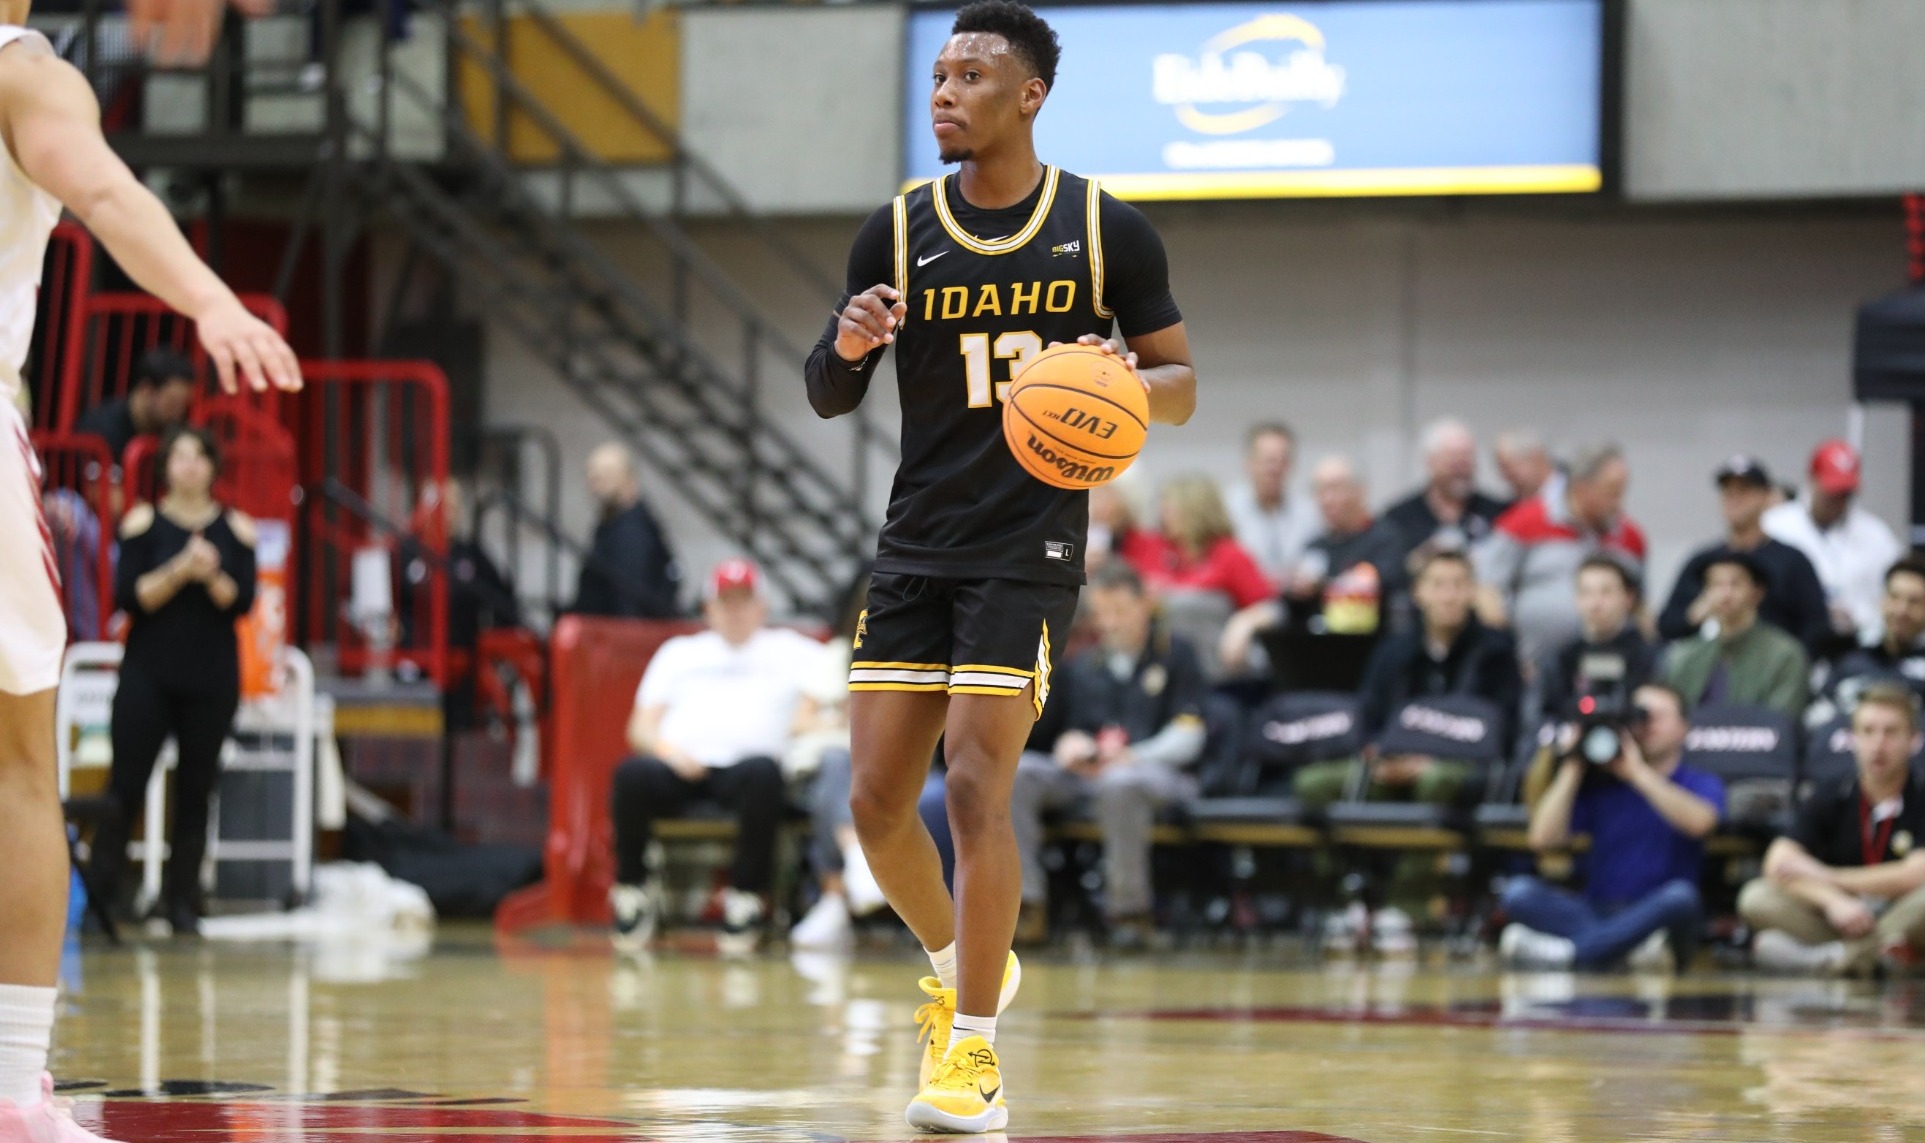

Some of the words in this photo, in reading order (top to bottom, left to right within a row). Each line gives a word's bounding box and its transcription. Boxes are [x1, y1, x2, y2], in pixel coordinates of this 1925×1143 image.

[923, 280, 1076, 320] IDAHO
[960, 330, 1042, 408] 13
[1060, 408, 1118, 439] EVO
[1027, 433, 1114, 482] Wilson
